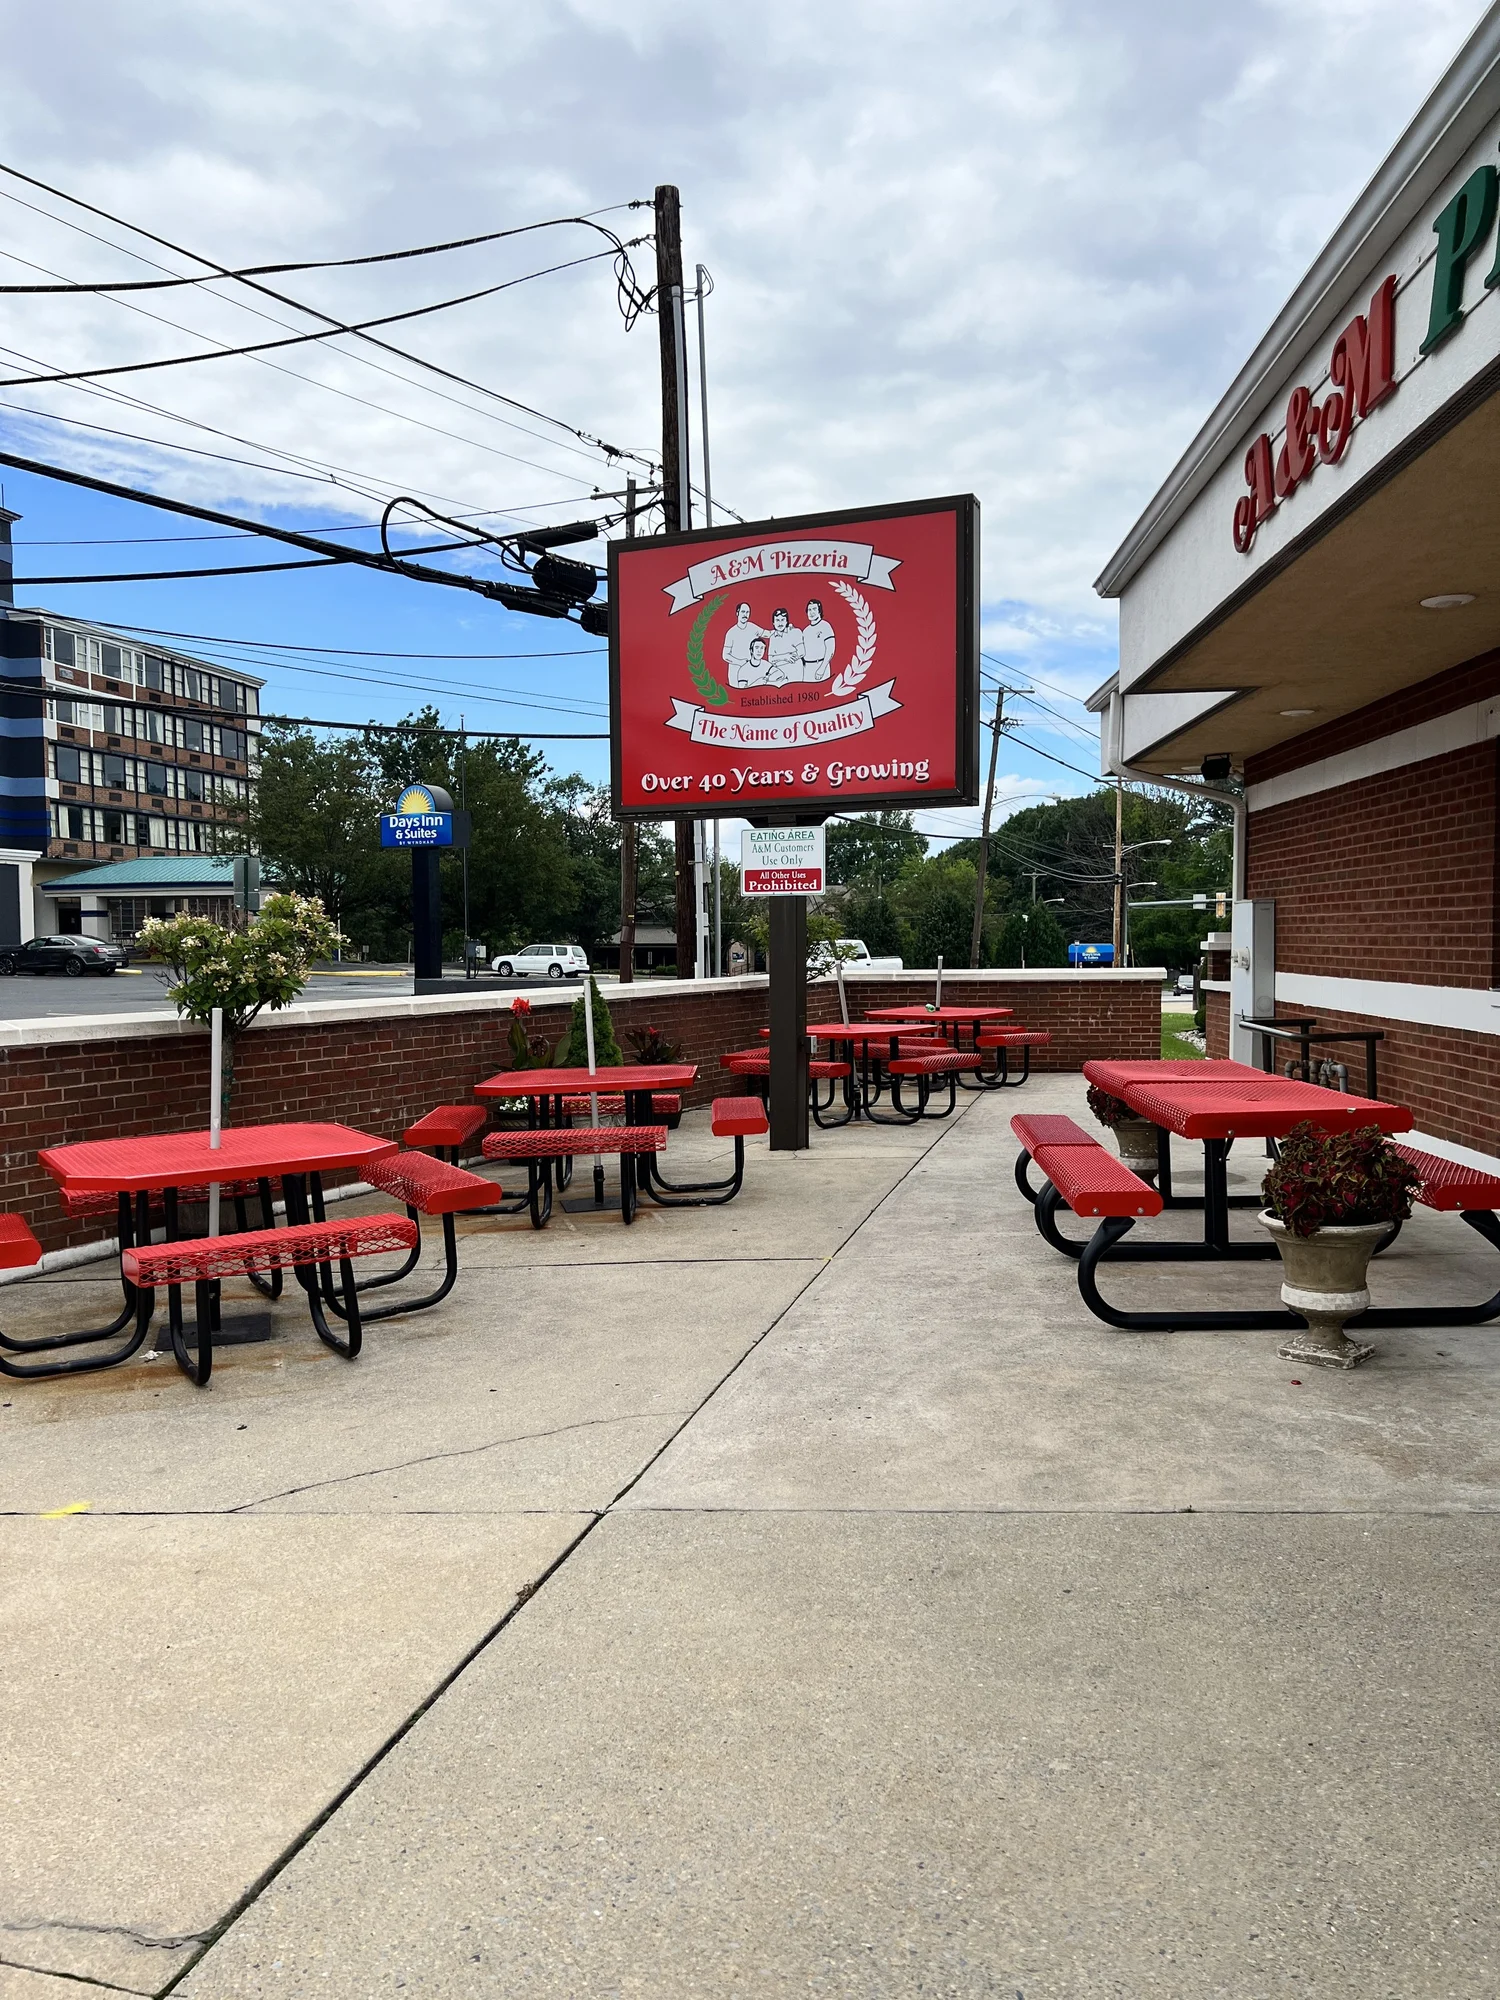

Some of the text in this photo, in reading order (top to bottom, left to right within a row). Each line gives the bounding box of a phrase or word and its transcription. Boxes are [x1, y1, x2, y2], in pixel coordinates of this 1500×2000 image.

[1233, 274, 1396, 553] A&M
[710, 549, 848, 586] A&M Pizzeria
[740, 691, 820, 708] Established 1980
[698, 711, 864, 743] The Name of Quality
[641, 758, 930, 793] Over 40 Years & Growing
[389, 815, 443, 828] Days Inn
[395, 828, 437, 839] & Suites
[750, 831, 815, 841] EATING AREA
[752, 842, 814, 854] A&M Customers
[762, 854, 803, 867] Use Only
[760, 871, 806, 879] All Other Uses
[748, 879, 817, 891] Prohibited
